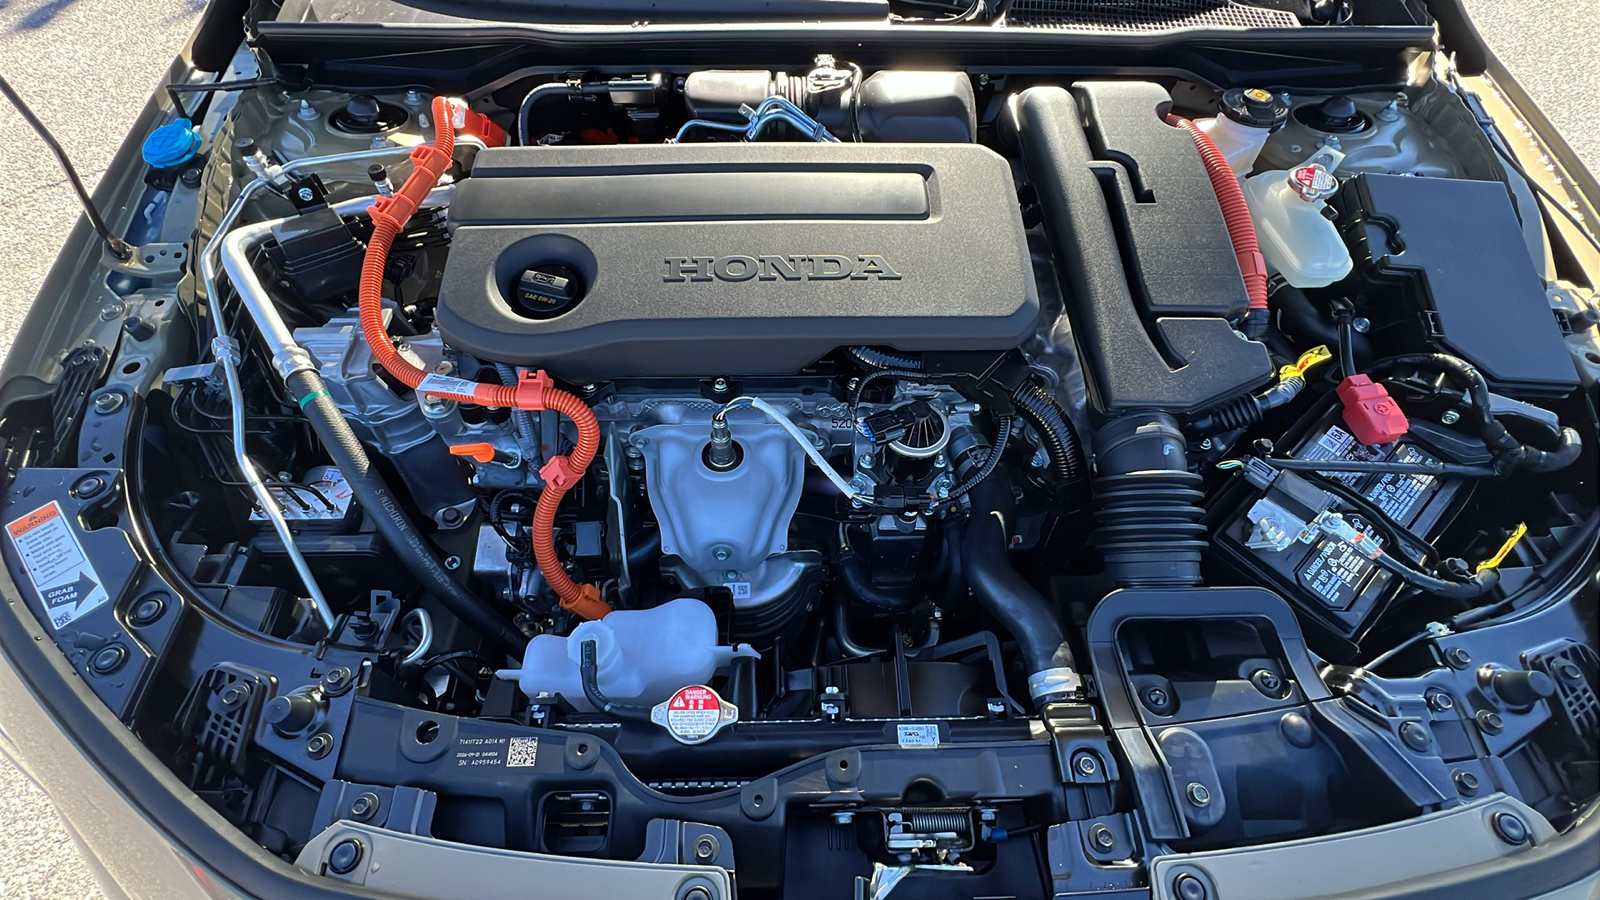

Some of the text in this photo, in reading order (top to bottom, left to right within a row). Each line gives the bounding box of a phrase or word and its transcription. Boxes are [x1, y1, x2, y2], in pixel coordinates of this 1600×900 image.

[663, 254, 902, 282] HONDA
[831, 418, 852, 428] 520
[1331, 427, 1346, 440] 5A
[380, 496, 408, 532] NICHIRIN
[13, 511, 57, 535] WARNING
[48, 586, 74, 598] GRAB
[51, 592, 78, 605] FOAM
